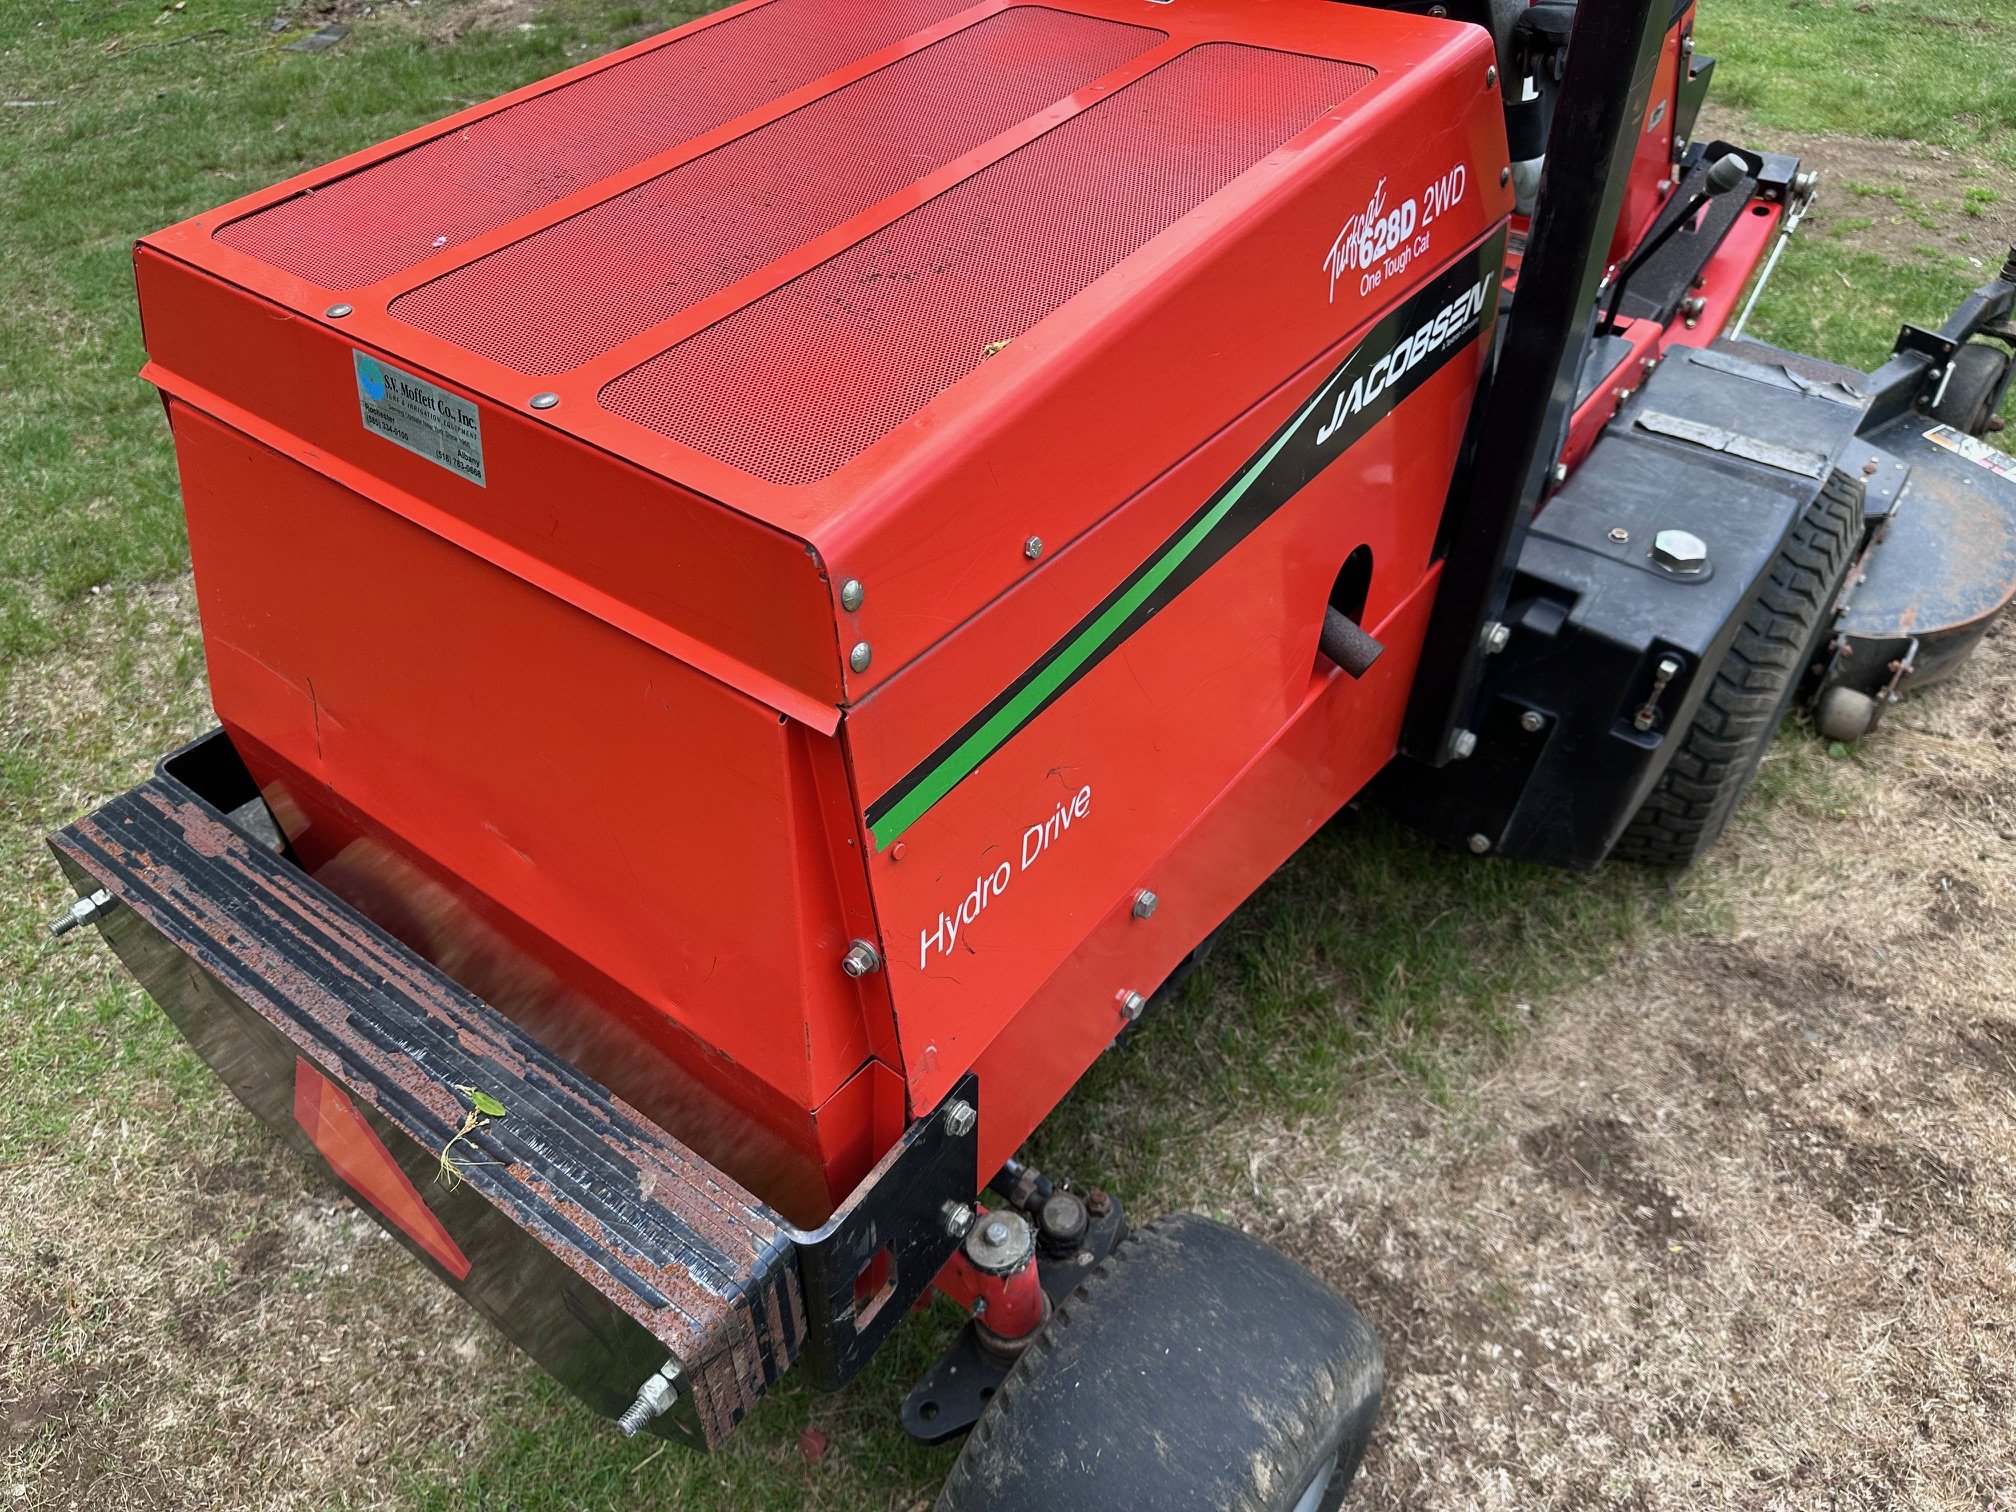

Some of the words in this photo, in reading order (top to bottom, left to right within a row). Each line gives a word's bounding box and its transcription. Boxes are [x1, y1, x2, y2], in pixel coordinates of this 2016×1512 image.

[1322, 176, 1387, 304] Turfcat
[1358, 198, 1417, 270] 628D
[1421, 164, 1467, 228] 2WD
[1359, 273, 1382, 297] One
[1383, 244, 1412, 274] Tough
[1413, 230, 1431, 258] Cat
[1316, 272, 1491, 446] JACOBSEN
[364, 402, 395, 424] Rochester
[384, 374, 399, 393] S.V.
[400, 381, 436, 411] Moffett
[437, 400, 456, 421] Co.,
[457, 408, 477, 430] Inc.
[407, 402, 441, 423] IRRIGATION
[443, 419, 477, 441] EQUIPMENT
[457, 449, 480, 468] Albany
[920, 861, 1012, 971] Hydro
[1021, 785, 1091, 872] Drive
